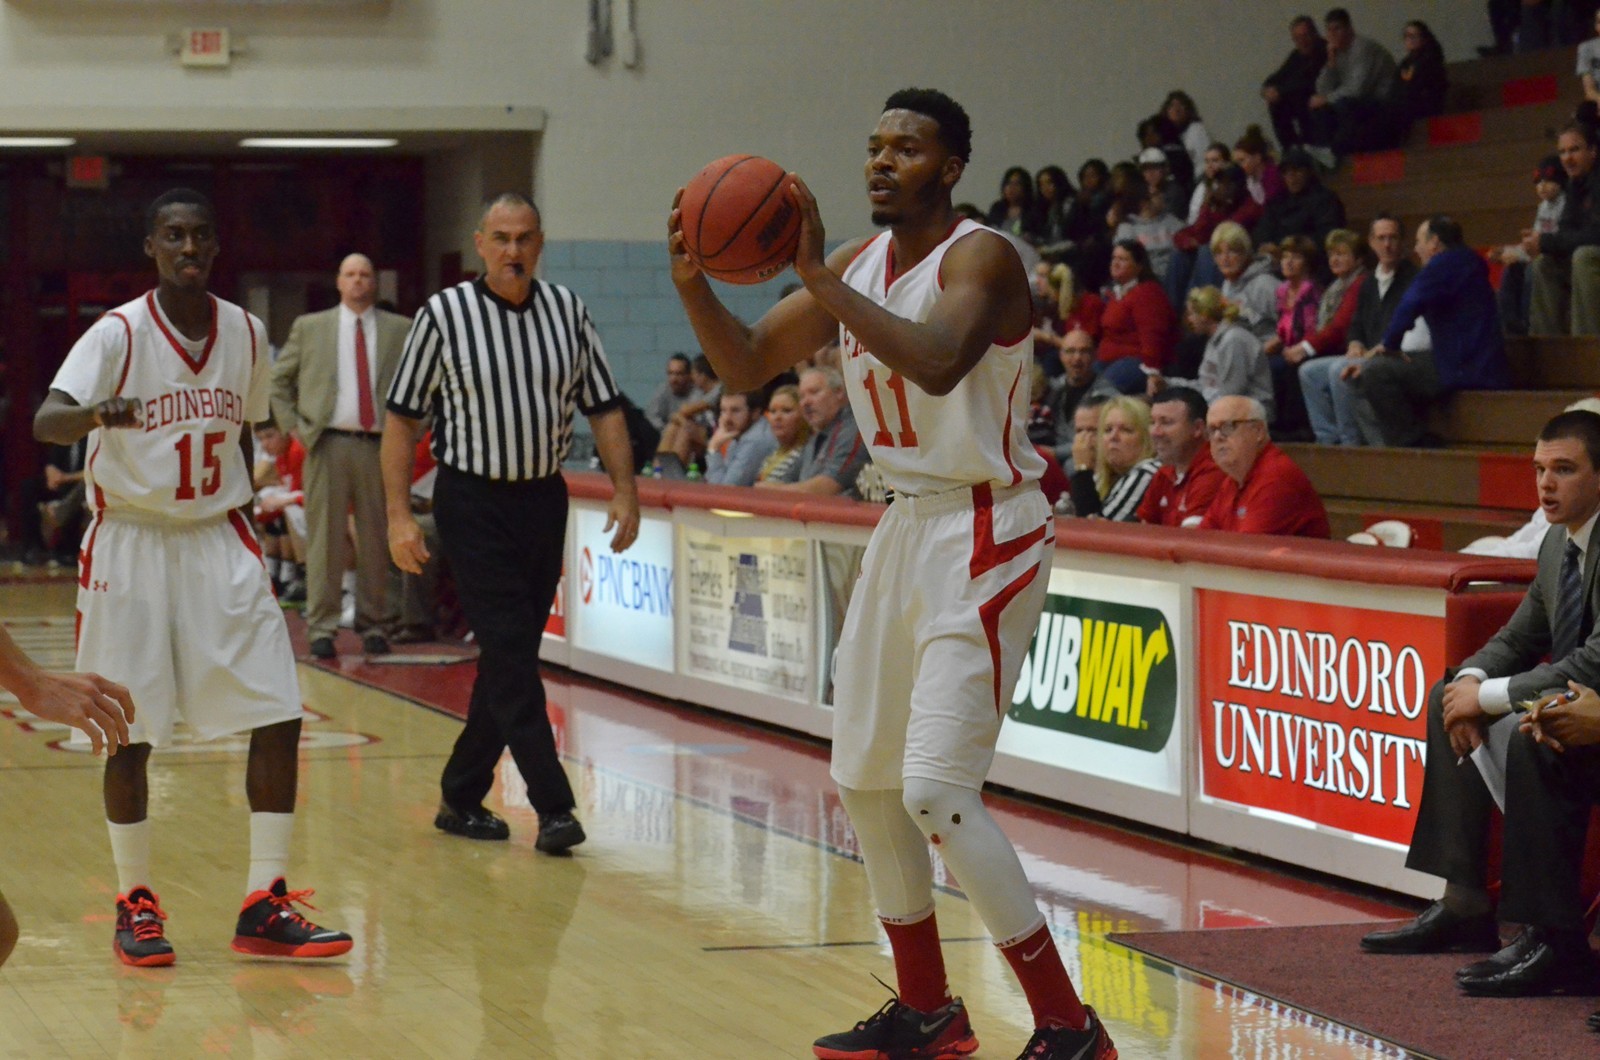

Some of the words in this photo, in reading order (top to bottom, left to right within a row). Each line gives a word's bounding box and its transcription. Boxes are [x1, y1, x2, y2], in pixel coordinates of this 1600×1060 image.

[191, 31, 221, 55] EXIT
[146, 388, 242, 432] EDINBORO
[863, 369, 918, 448] 11
[175, 431, 226, 501] 15
[1228, 620, 1426, 719] EDINBORO
[1212, 700, 1427, 809] UNIVERSIT
